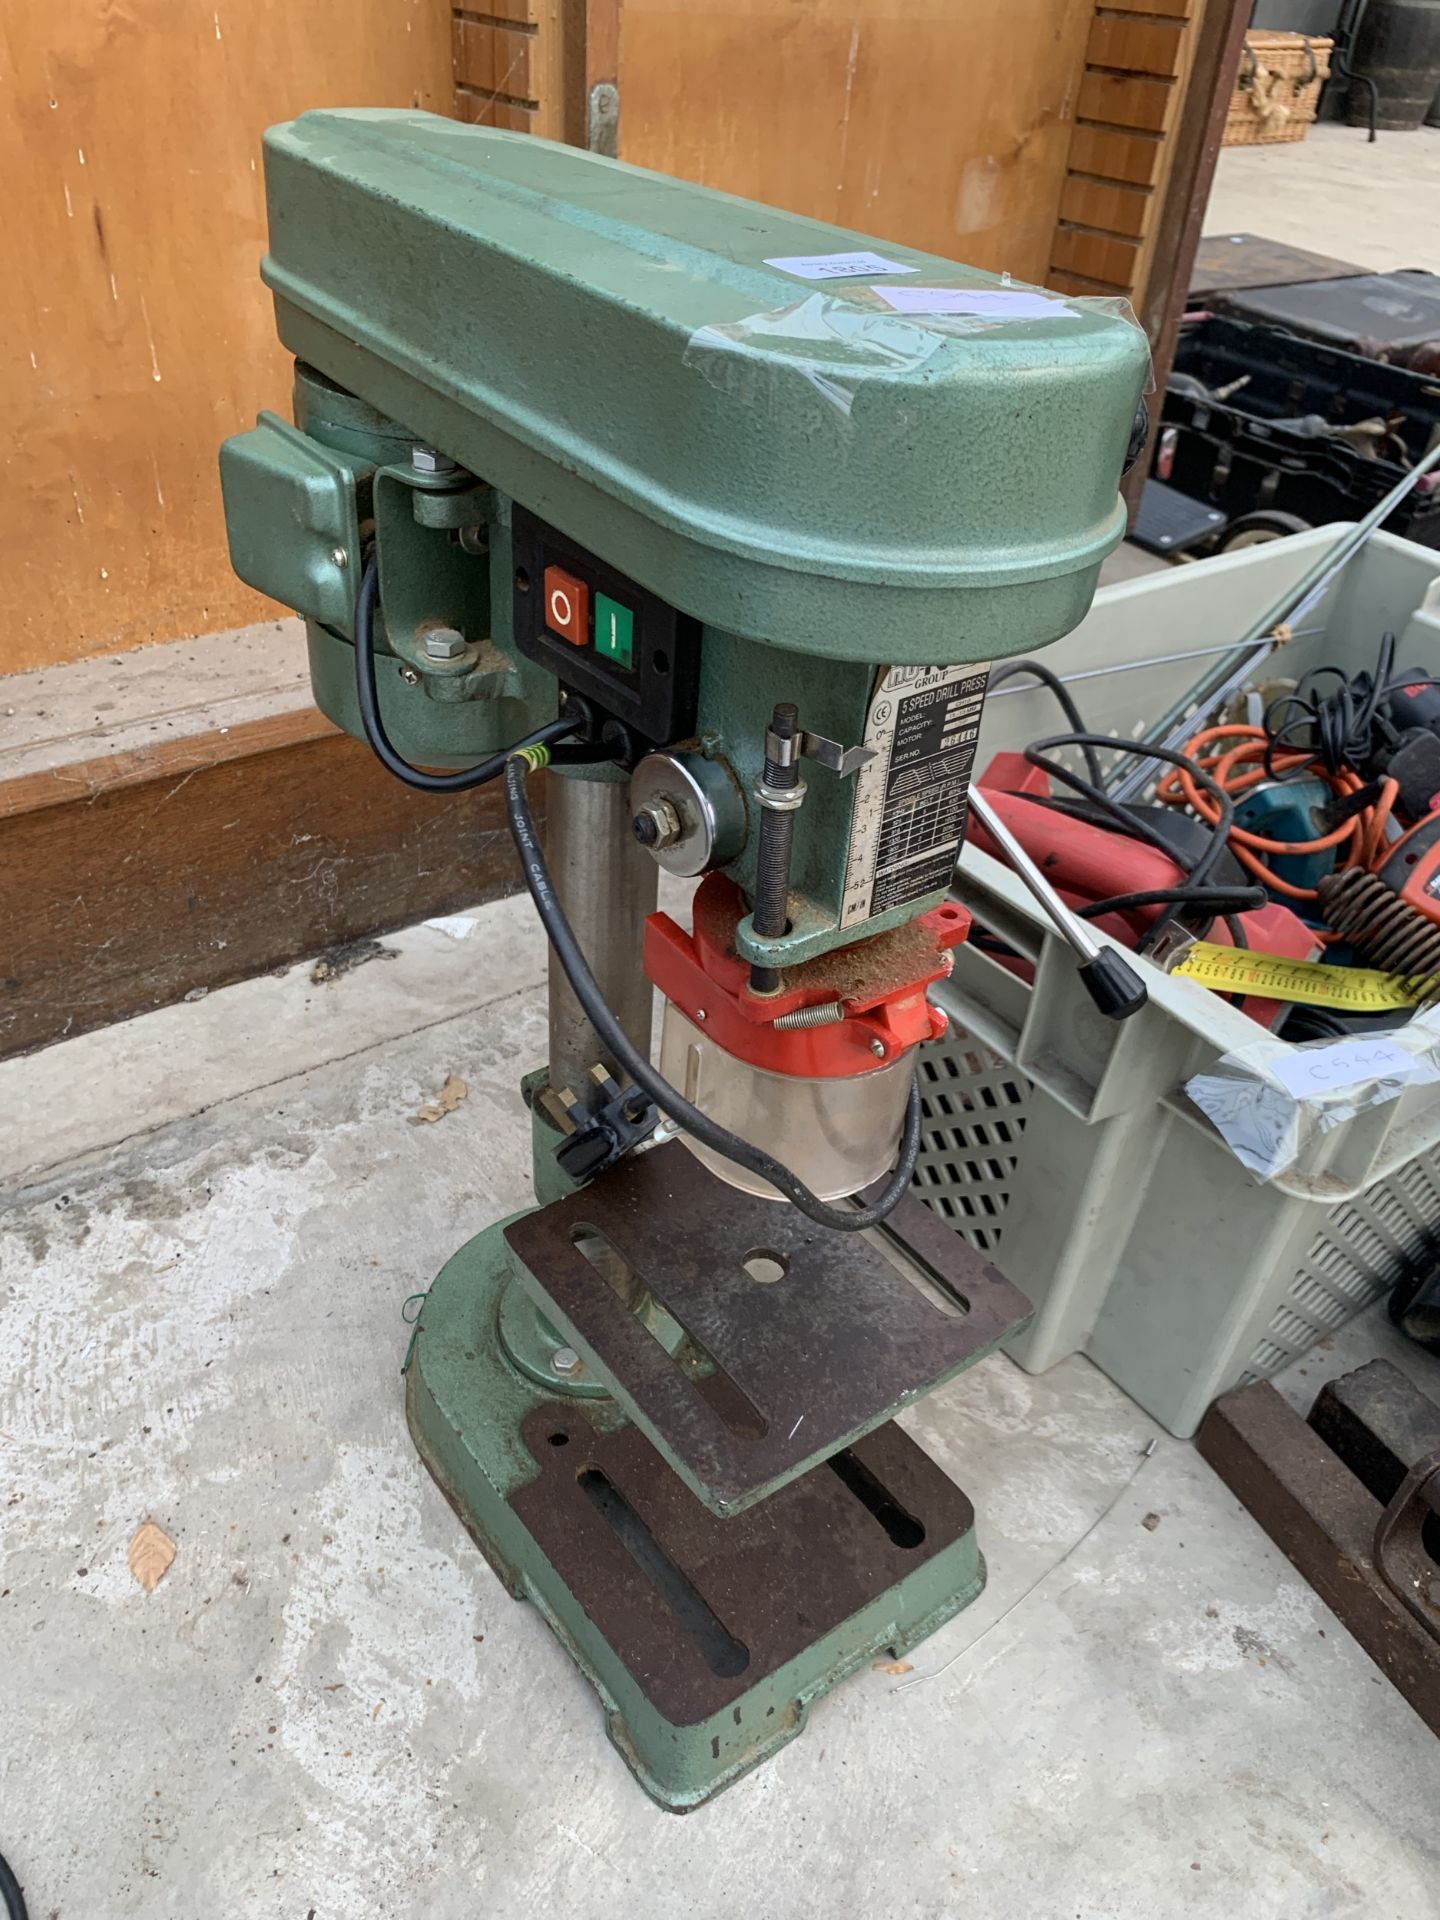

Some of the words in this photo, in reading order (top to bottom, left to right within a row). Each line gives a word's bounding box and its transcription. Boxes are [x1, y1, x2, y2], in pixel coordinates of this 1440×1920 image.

[914, 670, 949, 689] GROUP
[901, 700, 909, 714] 5
[909, 692, 935, 712] SPEED
[935, 684, 959, 703] DRILL
[960, 675, 987, 694] PRESS
[864, 794, 871, 804] 2
[861, 824, 867, 834] 3
[514, 813, 533, 849] JOINT
[530, 863, 553, 911] CABLE
